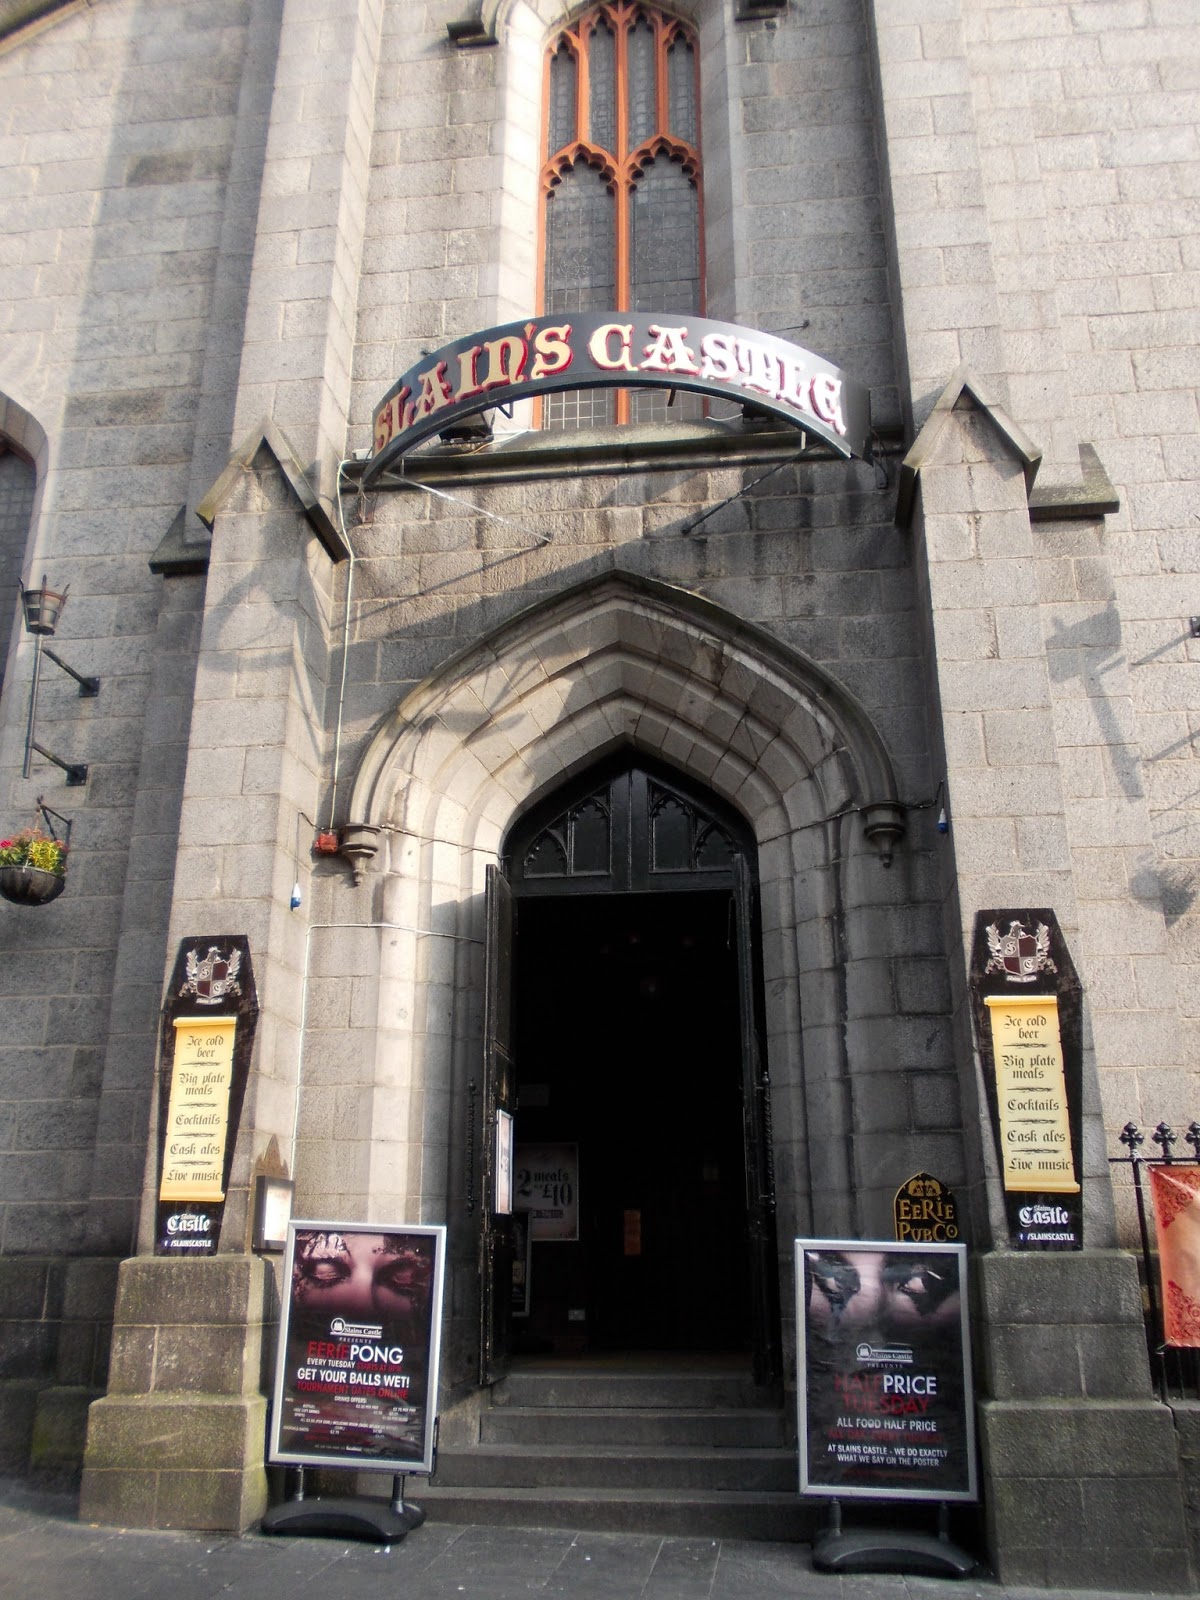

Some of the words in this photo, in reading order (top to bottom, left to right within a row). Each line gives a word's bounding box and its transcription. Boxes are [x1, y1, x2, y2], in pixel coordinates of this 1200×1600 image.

[374, 322, 573, 451] SLAIN'S
[587, 323, 846, 435] CASTLE
[1004, 1015, 1021, 1028] Ice
[1027, 1015, 1046, 1026] cold
[1018, 1028, 1040, 1038] beer
[186, 1036, 202, 1047] Ice
[206, 1035, 224, 1046] cold
[197, 1048, 216, 1058] beer
[1002, 1055, 1024, 1069] Big
[1030, 1055, 1056, 1068] plate
[179, 1073, 198, 1086] Big
[202, 1072, 224, 1084] plate
[1013, 1068, 1044, 1078] meals
[185, 1084, 212, 1095] meals
[1008, 1099, 1059, 1112] Cocktails
[176, 1114, 220, 1126] Cocktails
[1008, 1130, 1037, 1144] Cask
[1043, 1130, 1066, 1142] ales
[170, 1143, 196, 1156] Cask
[200, 1143, 220, 1154] ales
[1008, 1158, 1032, 1171] Live
[1038, 1159, 1070, 1170] music
[166, 1170, 188, 1182] Live
[192, 1170, 220, 1180] music
[518, 1168, 532, 1197] 2
[534, 1169, 568, 1181] meals
[542, 1184, 572, 1207] £10
[898, 1198, 954, 1223] EERIE
[1020, 1206, 1068, 1227] Castle
[167, 1214, 210, 1234] Castle
[363, 1328, 382, 1336] Castle
[350, 1344, 403, 1364] PONG
[306, 1358, 326, 1366] EVERY
[328, 1360, 356, 1369] TUESDAY
[298, 1368, 317, 1381] GET
[320, 1370, 346, 1384] YOUR
[350, 1372, 380, 1386] BALLS
[384, 1374, 410, 1388] WET!
[884, 1374, 936, 1394] PRICE
[298, 1380, 349, 1394] TOURNAMENT
[352, 1384, 378, 1396] DATES
[844, 1394, 930, 1415] TUESDAY
[837, 1418, 853, 1428] ALL
[856, 1418, 882, 1428] FOOD
[884, 1420, 907, 1430] HALF
[910, 1420, 936, 1432] PRICE
[828, 1444, 836, 1452] AT
[838, 1444, 862, 1454] SLAINS
[863, 1446, 888, 1454] CASTLE
[894, 1448, 906, 1456] WE
[908, 1448, 918, 1456] DO
[920, 1448, 948, 1458] EXACTLY
[837, 1454, 856, 1462] WHAT
[872, 1456, 884, 1464] SAY
[899, 1458, 911, 1466] THE
[914, 1458, 940, 1466] POSTER
